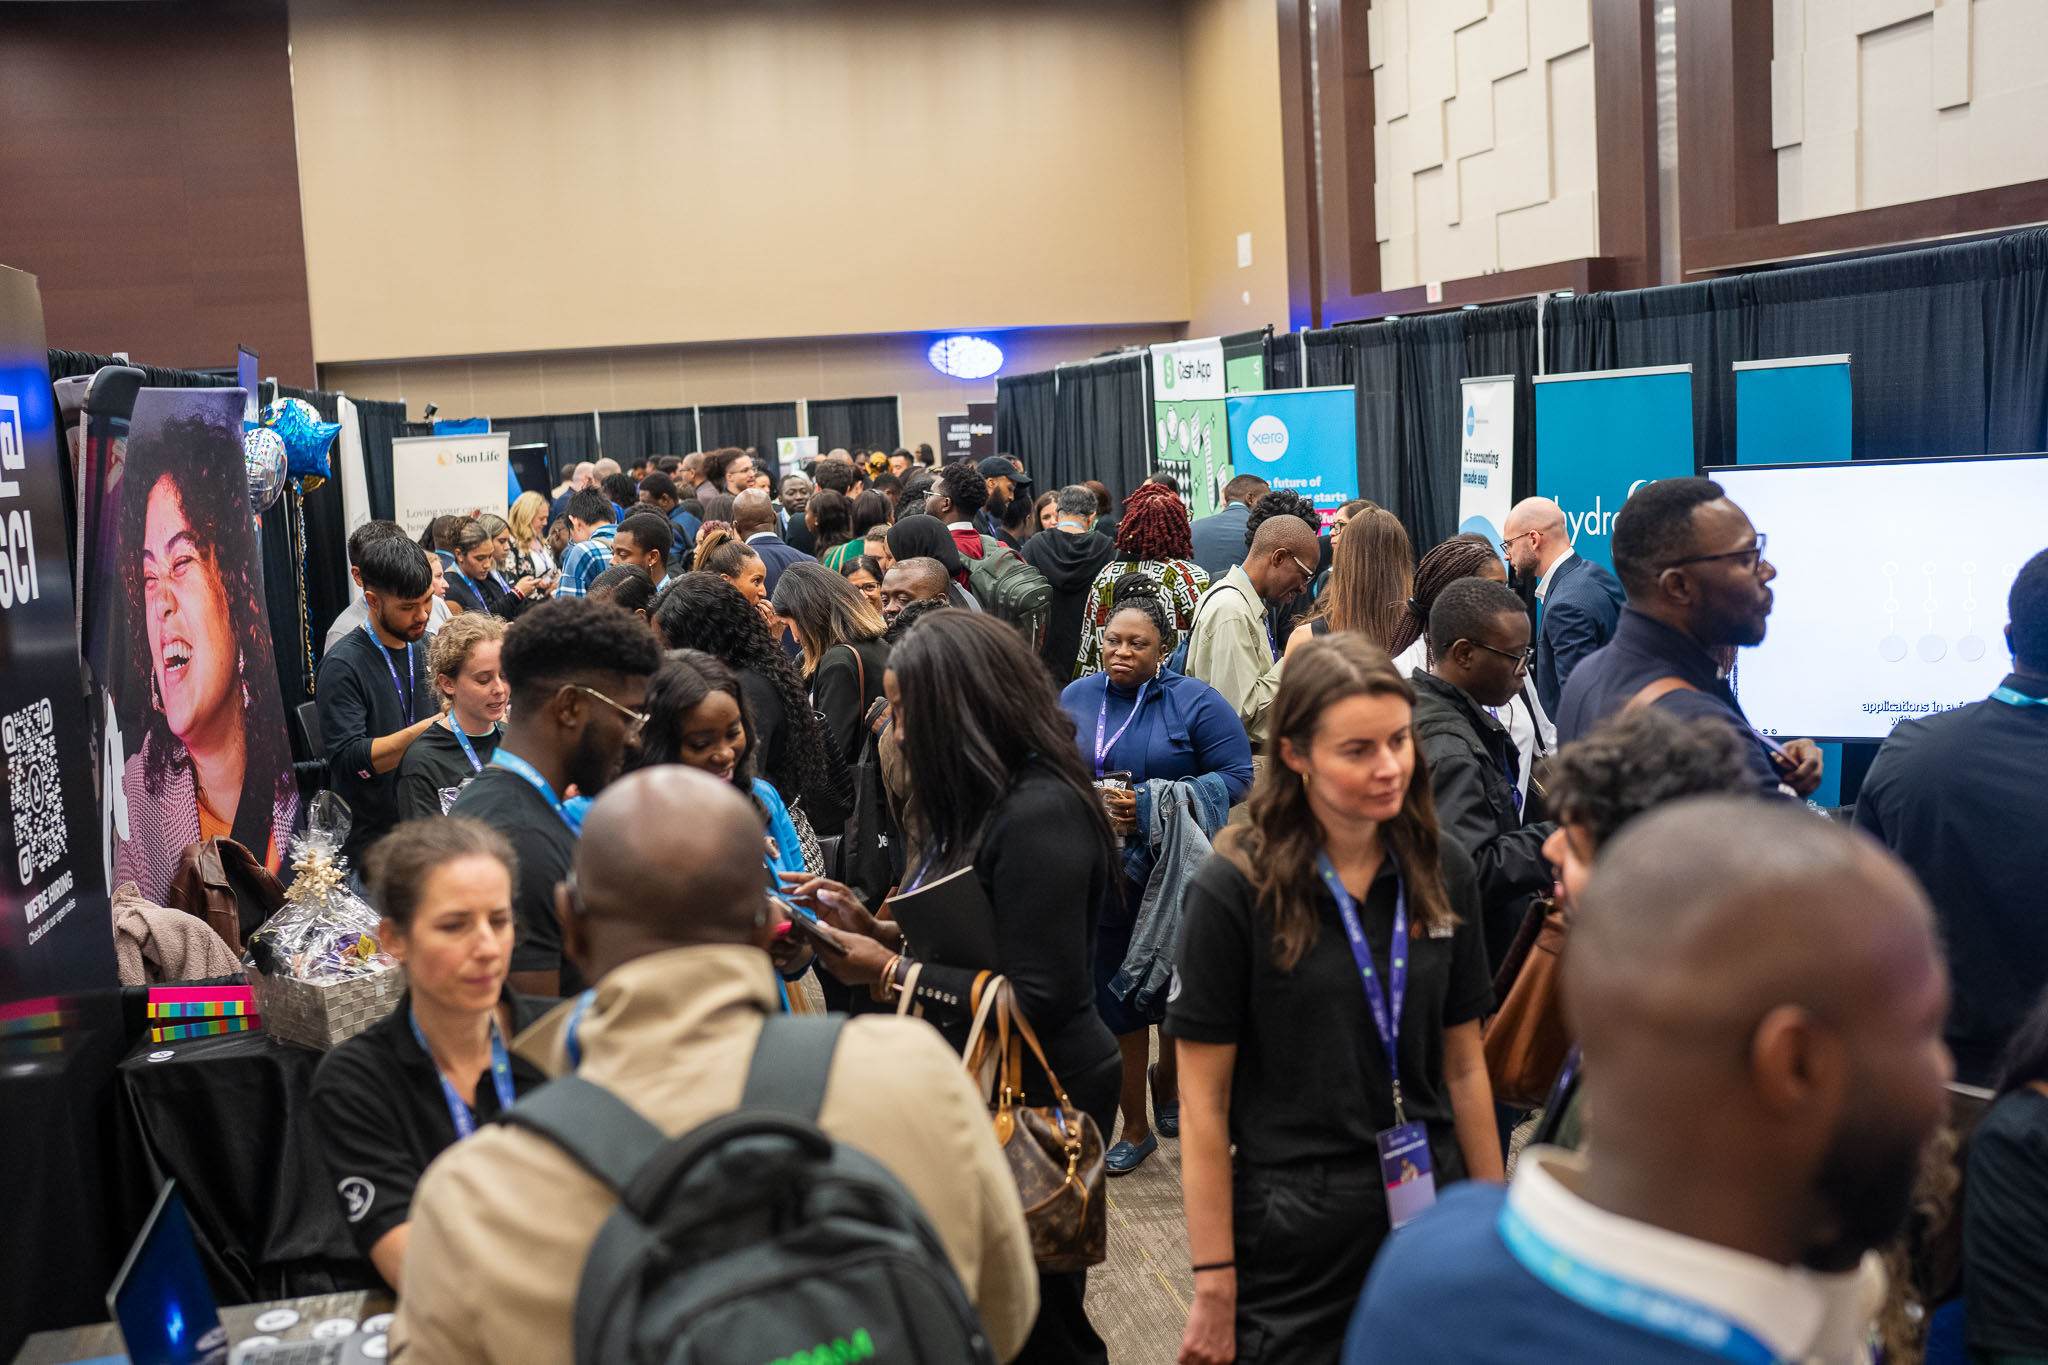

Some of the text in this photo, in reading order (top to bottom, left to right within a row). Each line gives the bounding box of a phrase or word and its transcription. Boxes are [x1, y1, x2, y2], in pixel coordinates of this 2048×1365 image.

[1178, 361, 1194, 379] Cash
[1196, 359, 1211, 382] App
[1252, 432, 1284, 445] xero
[456, 450, 500, 464] Sun Life
[1474, 450, 1499, 469] accounting
[1273, 477, 1307, 488] future
[1309, 476, 1322, 487] of
[1464, 470, 1488, 488] made easy
[1314, 492, 1347, 503] starts
[406, 508, 438, 519] Loving
[440, 507, 461, 518] your
[1862, 701, 1929, 714] applications
[1932, 701, 1943, 712] in
[47, 870, 73, 906] HIRING
[28, 925, 43, 946] Check
